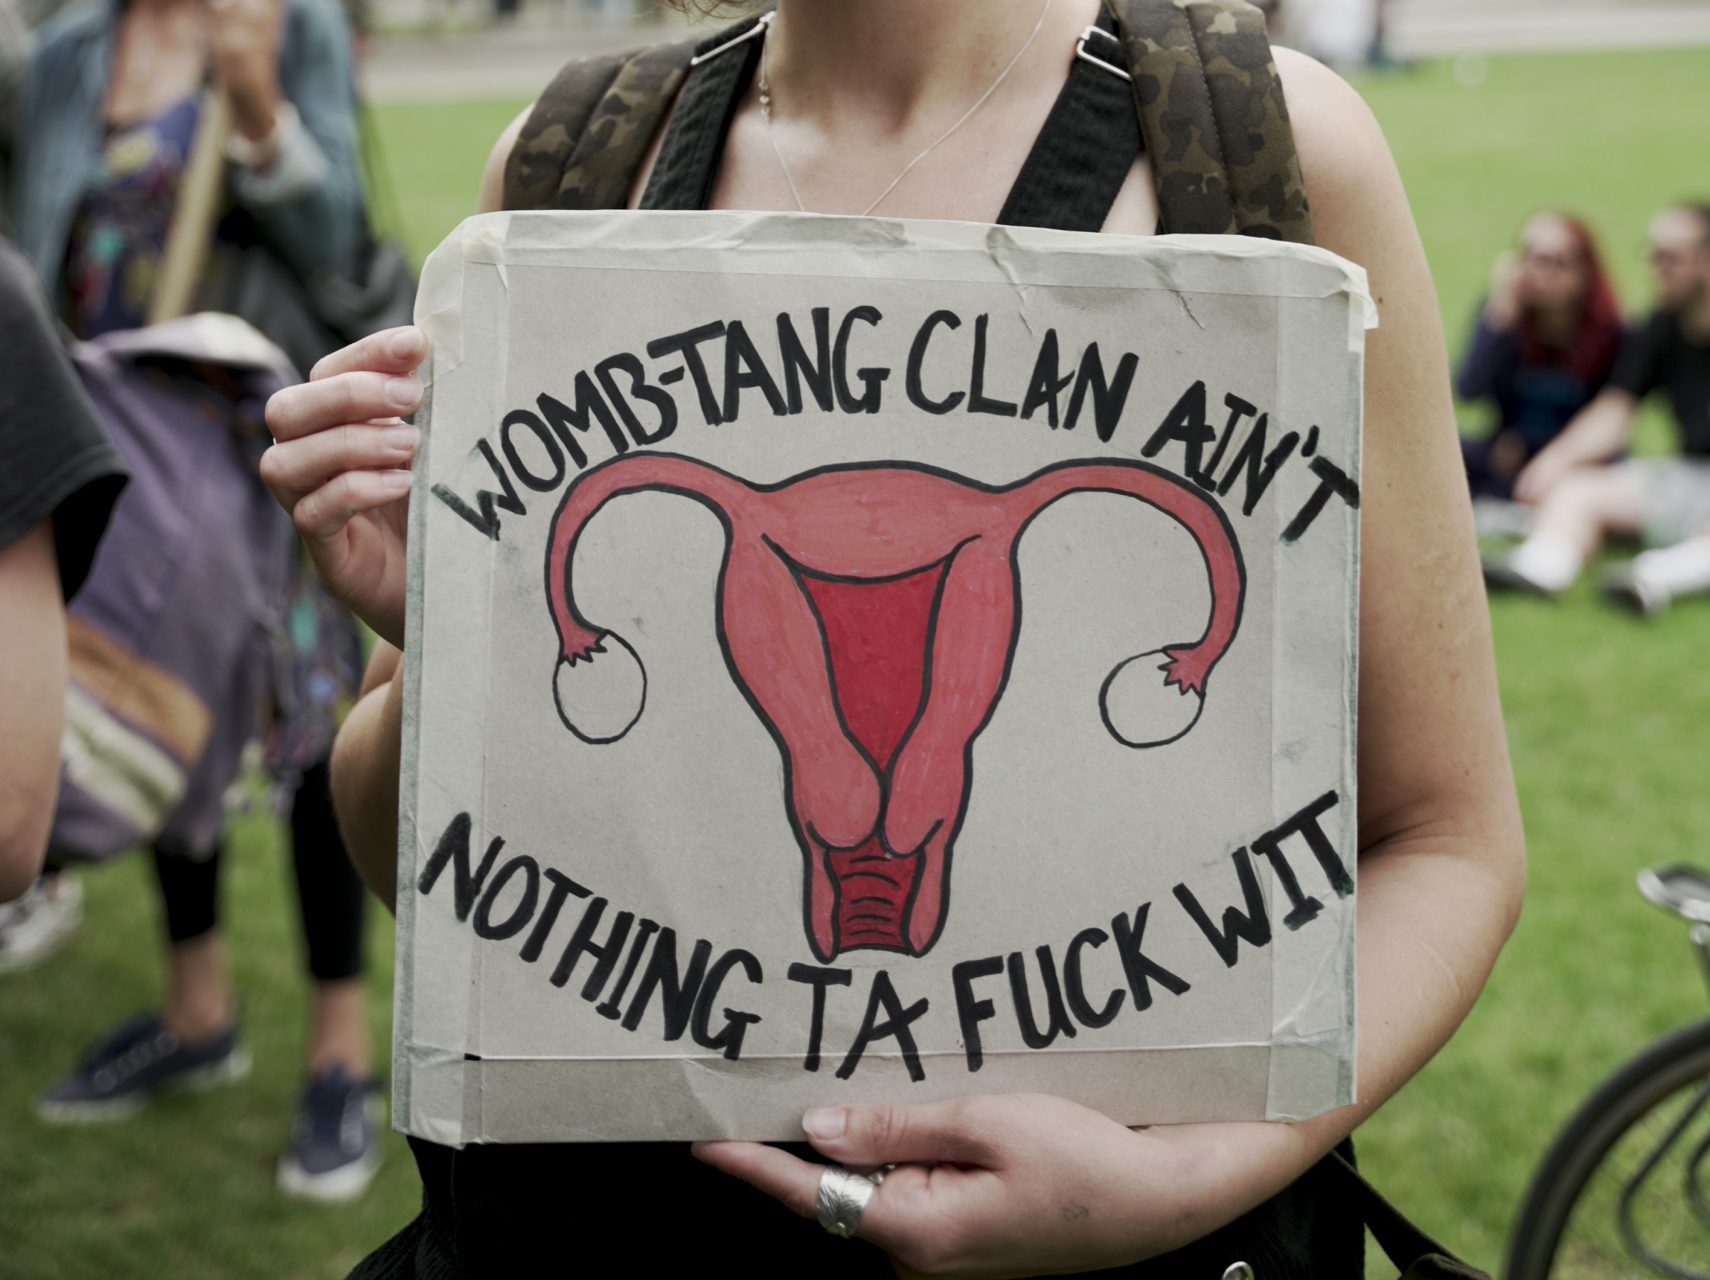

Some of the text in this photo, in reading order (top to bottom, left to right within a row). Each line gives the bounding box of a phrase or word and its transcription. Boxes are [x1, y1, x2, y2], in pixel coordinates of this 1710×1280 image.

[432, 306, 1360, 544] WOMB-TANG CLAN AIN'T
[417, 791, 1354, 1081] NOTHING TA FUCK WIT
